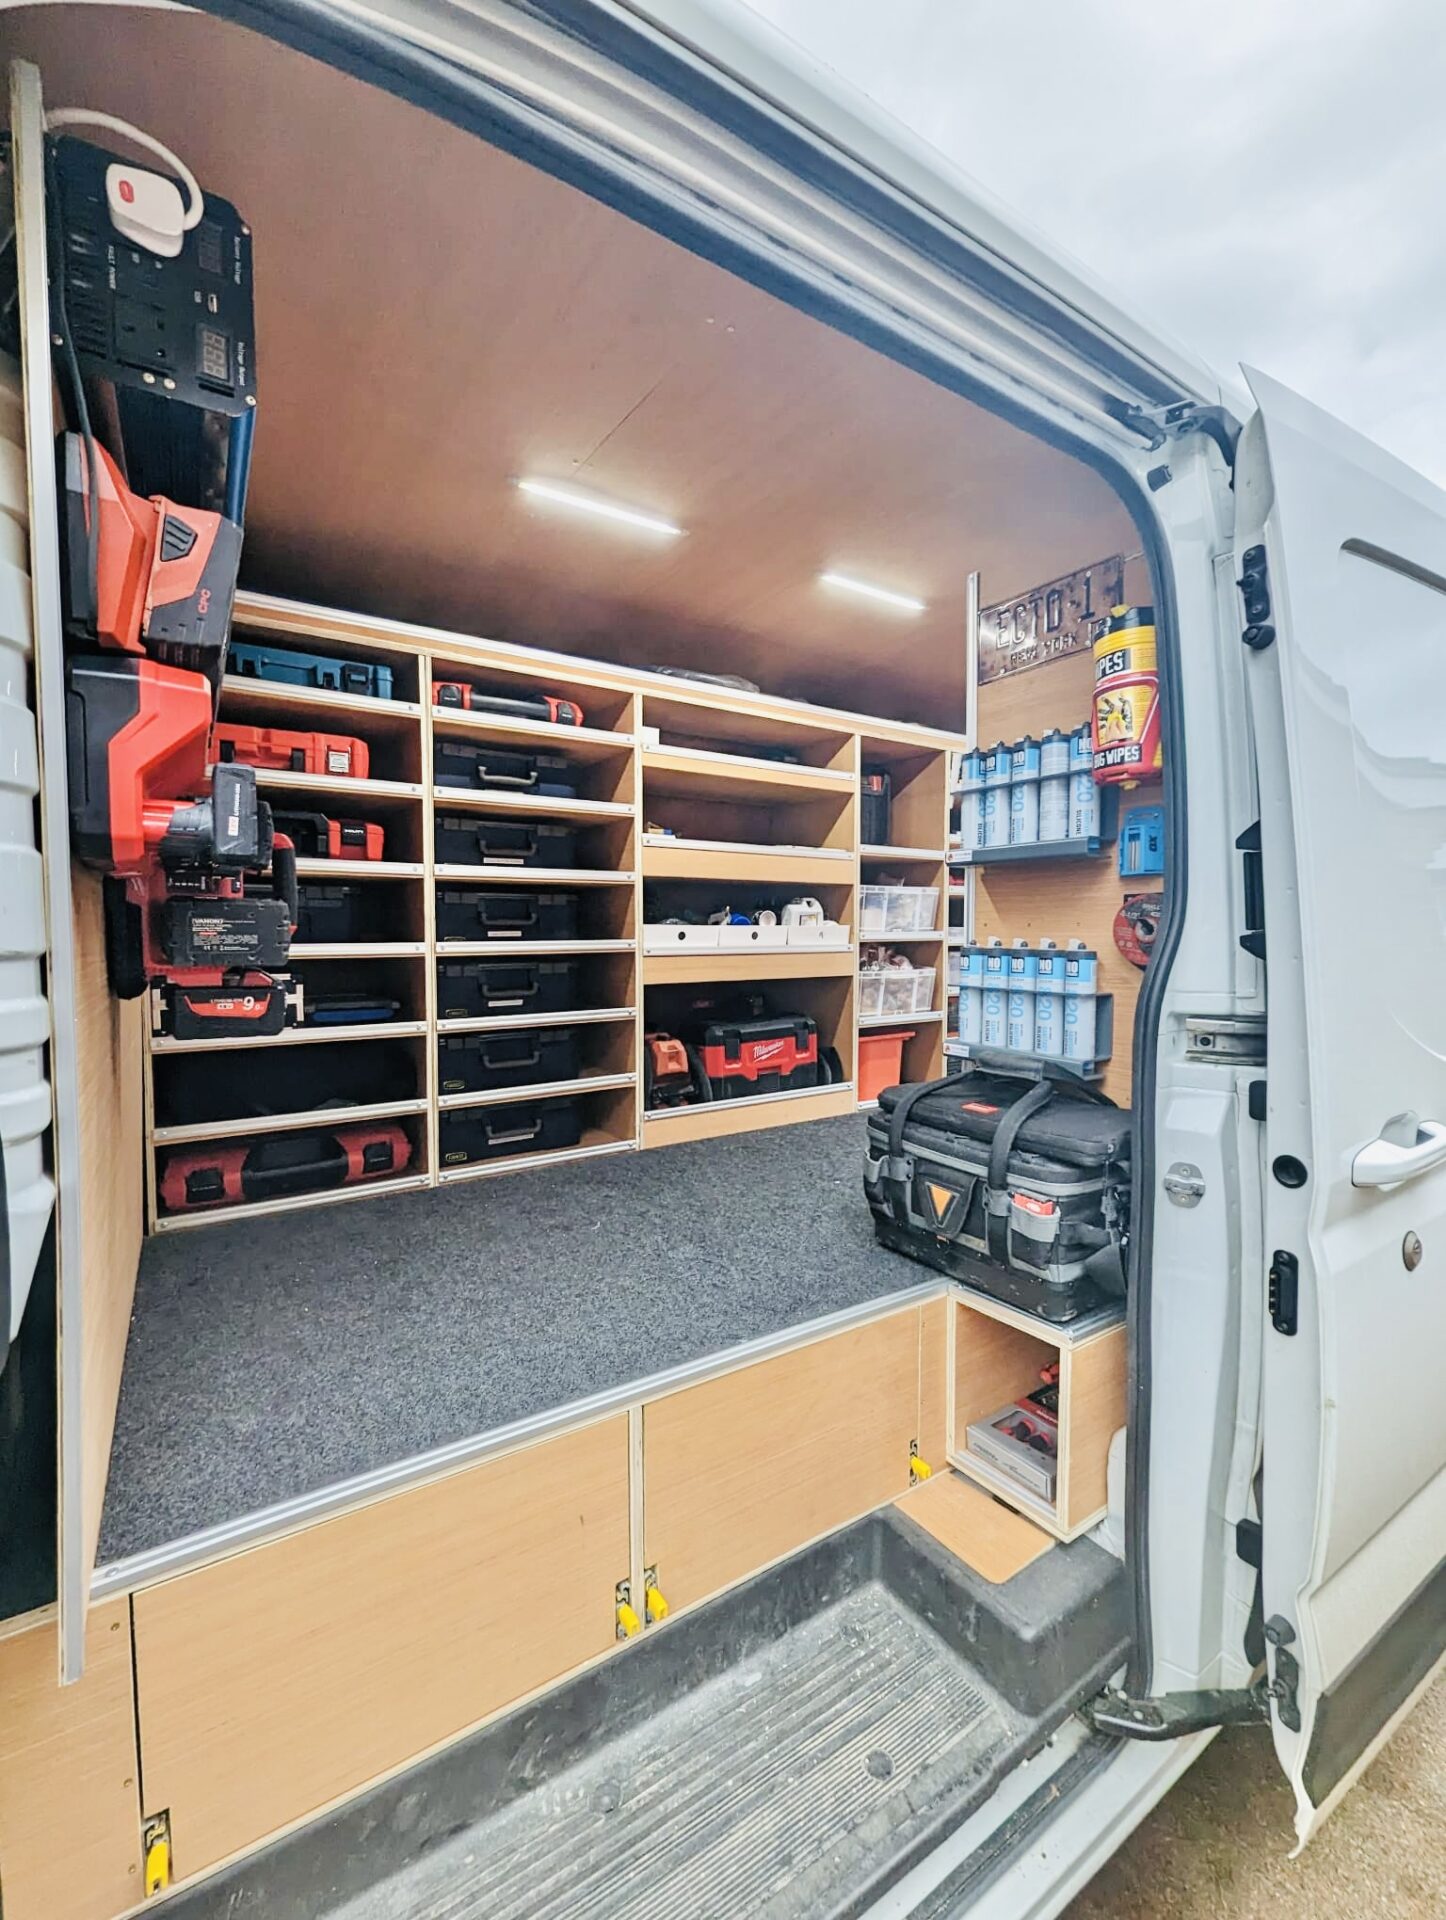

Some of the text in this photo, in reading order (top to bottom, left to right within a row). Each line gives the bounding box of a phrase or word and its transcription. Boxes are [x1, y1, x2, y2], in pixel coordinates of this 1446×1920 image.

[996, 570, 1096, 649] ECTO-1
[1010, 632, 1078, 666] NEW YORK
[1096, 651, 1124, 680] PES
[1106, 745, 1140, 765] WIPES
